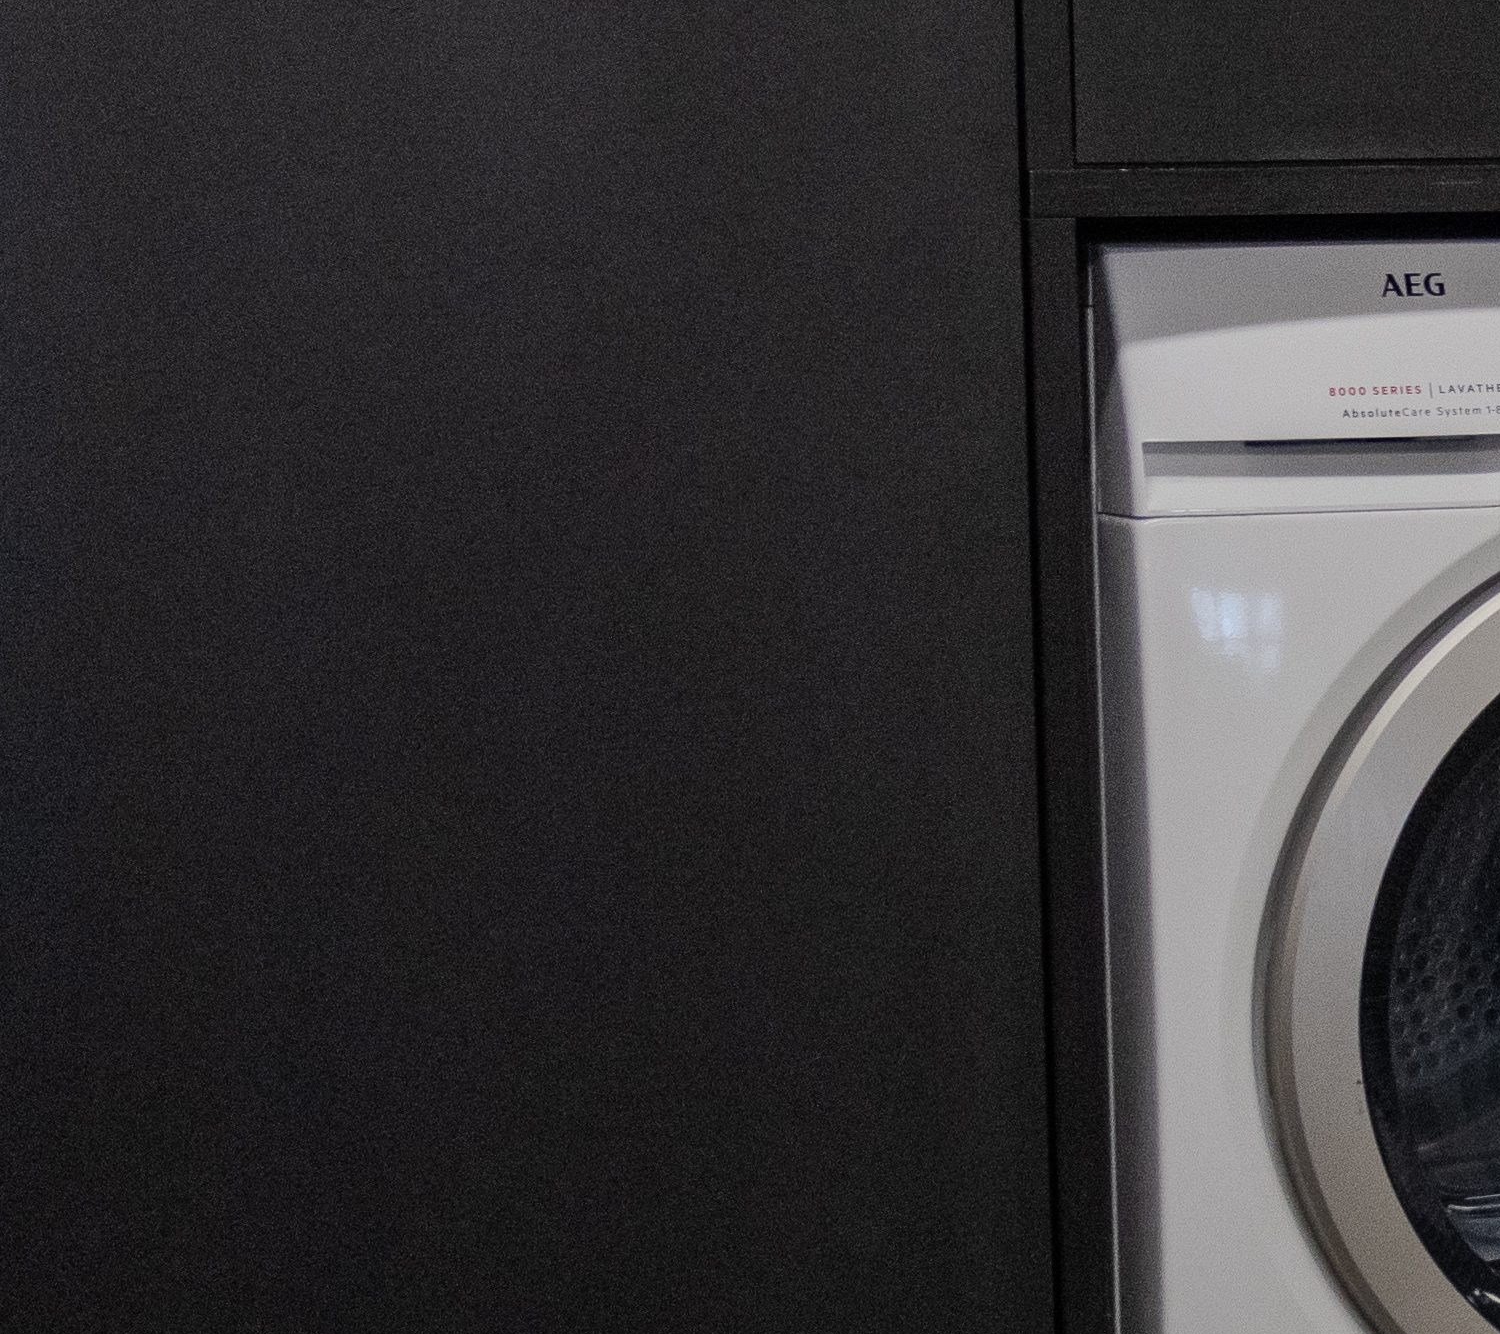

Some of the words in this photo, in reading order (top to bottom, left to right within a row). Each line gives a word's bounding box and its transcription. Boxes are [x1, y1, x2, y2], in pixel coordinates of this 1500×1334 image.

[1382, 272, 1446, 297] AEG
[1328, 386, 1367, 397] 8000
[1372, 385, 1422, 396] SERIES
[1342, 407, 1431, 418] AbsoluteCare
[1437, 405, 1482, 417] System
